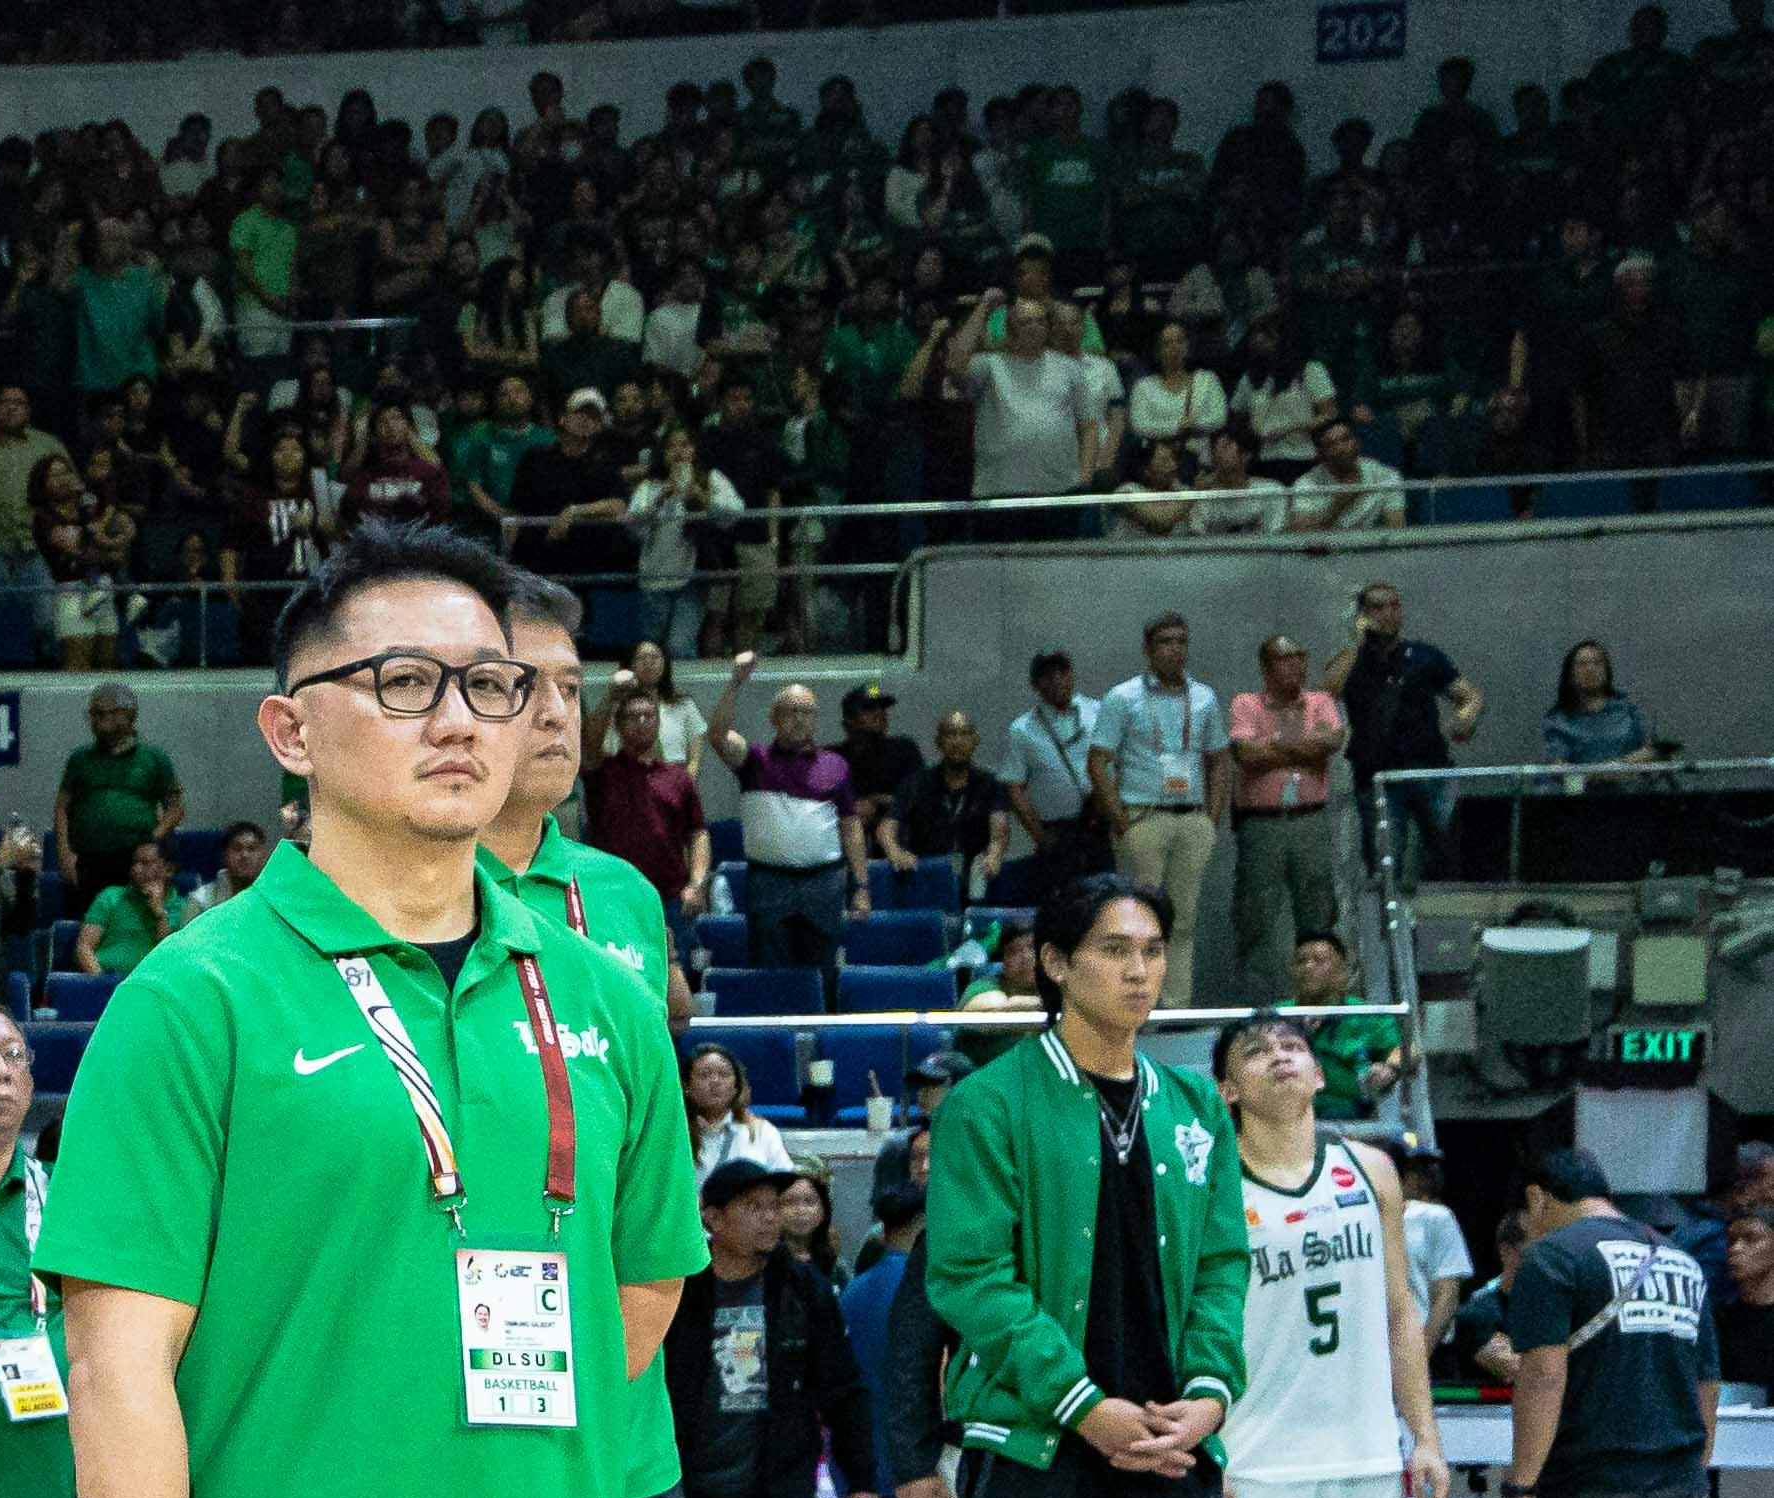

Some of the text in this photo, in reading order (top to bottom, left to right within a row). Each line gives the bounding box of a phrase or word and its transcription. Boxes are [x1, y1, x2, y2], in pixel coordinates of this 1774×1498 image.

[1321, 11, 1401, 51] 202
[1621, 1028, 1697, 1063] EXIT
[1251, 1244, 1296, 1287] La
[541, 1288, 557, 1312] C
[1303, 1281, 1342, 1357] 5
[492, 1351, 546, 1367] DLSU
[484, 1377, 559, 1391] BASKETBALL
[498, 1396, 546, 1413] 1 3
